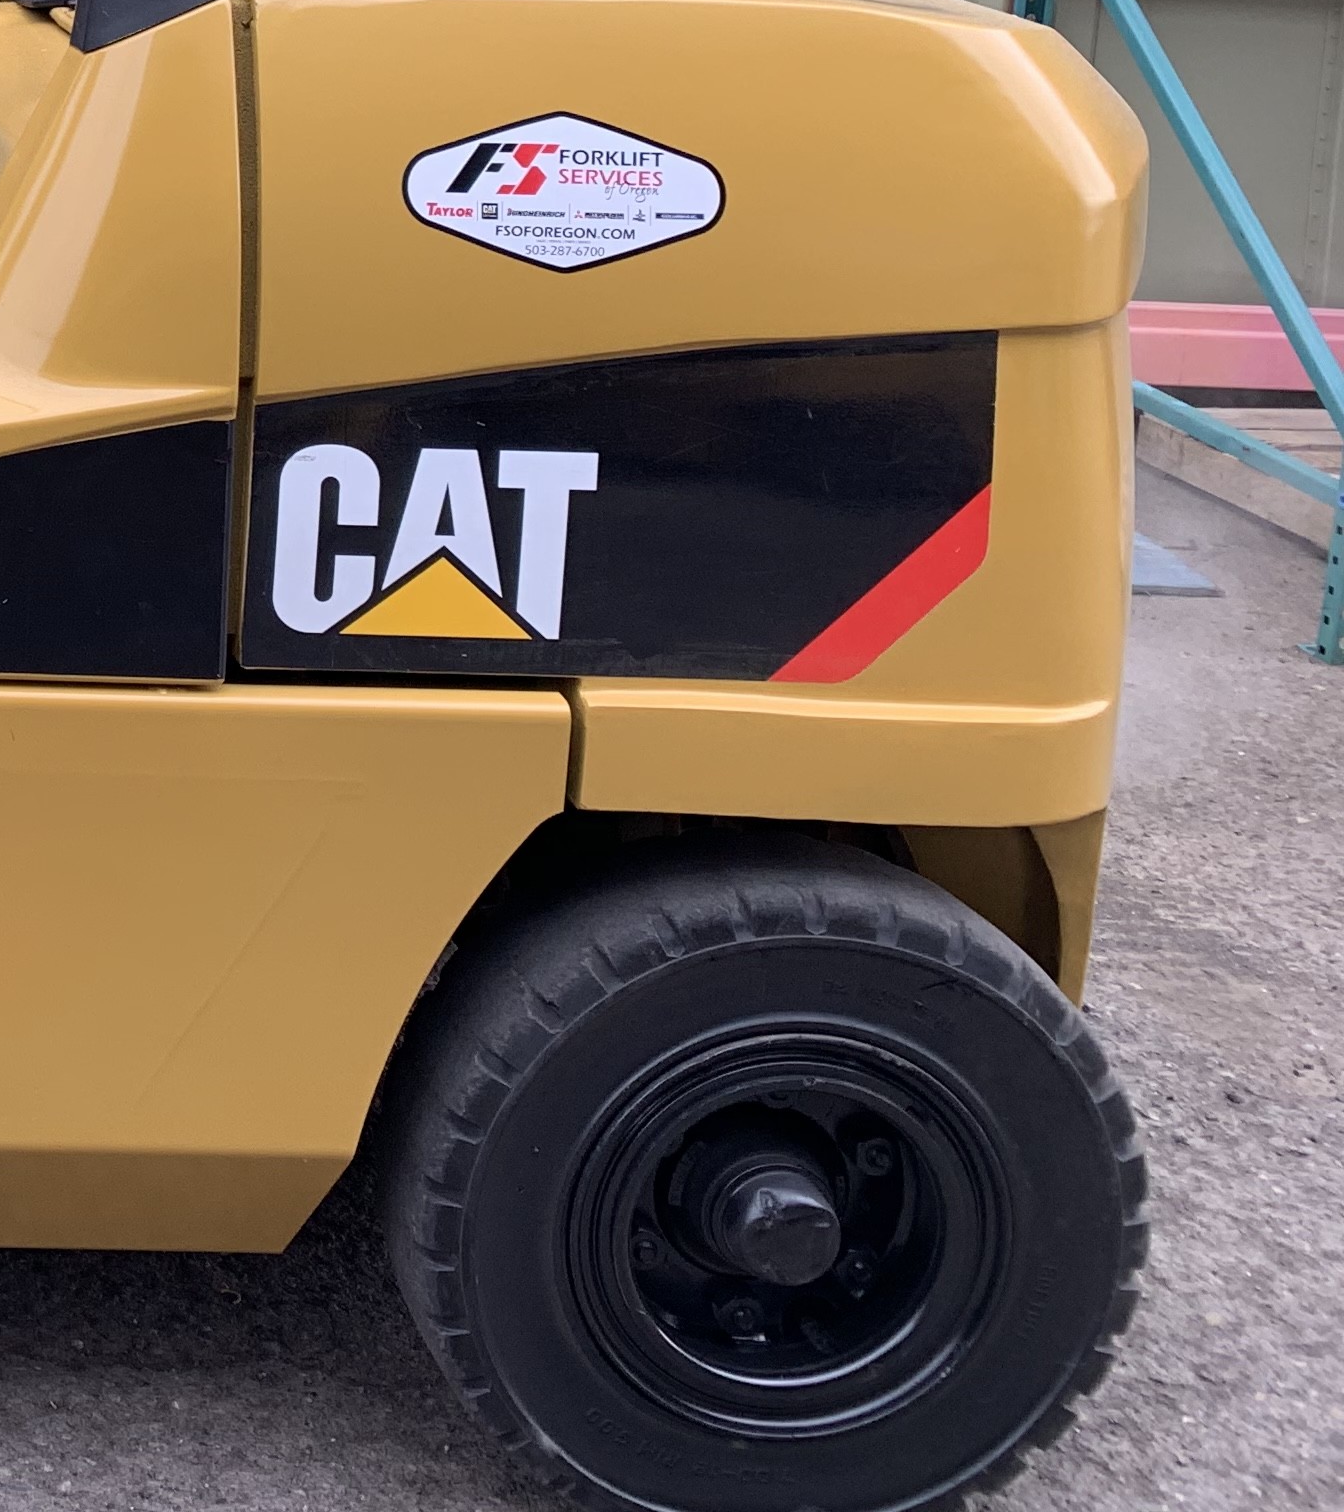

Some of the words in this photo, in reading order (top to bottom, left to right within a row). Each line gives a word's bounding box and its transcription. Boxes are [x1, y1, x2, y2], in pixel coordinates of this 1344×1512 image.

[445, 143, 560, 195] FS
[559, 149, 664, 167] FORKLIFT
[558, 168, 663, 187] SERVICES
[604, 181, 617, 200] of
[619, 182, 659, 203] Oregon
[427, 202, 473, 217] TAYLOR
[495, 225, 635, 240] FSOFOREGON.COM
[525, 245, 605, 257] 503-287-6700
[272, 443, 600, 640] CAT
